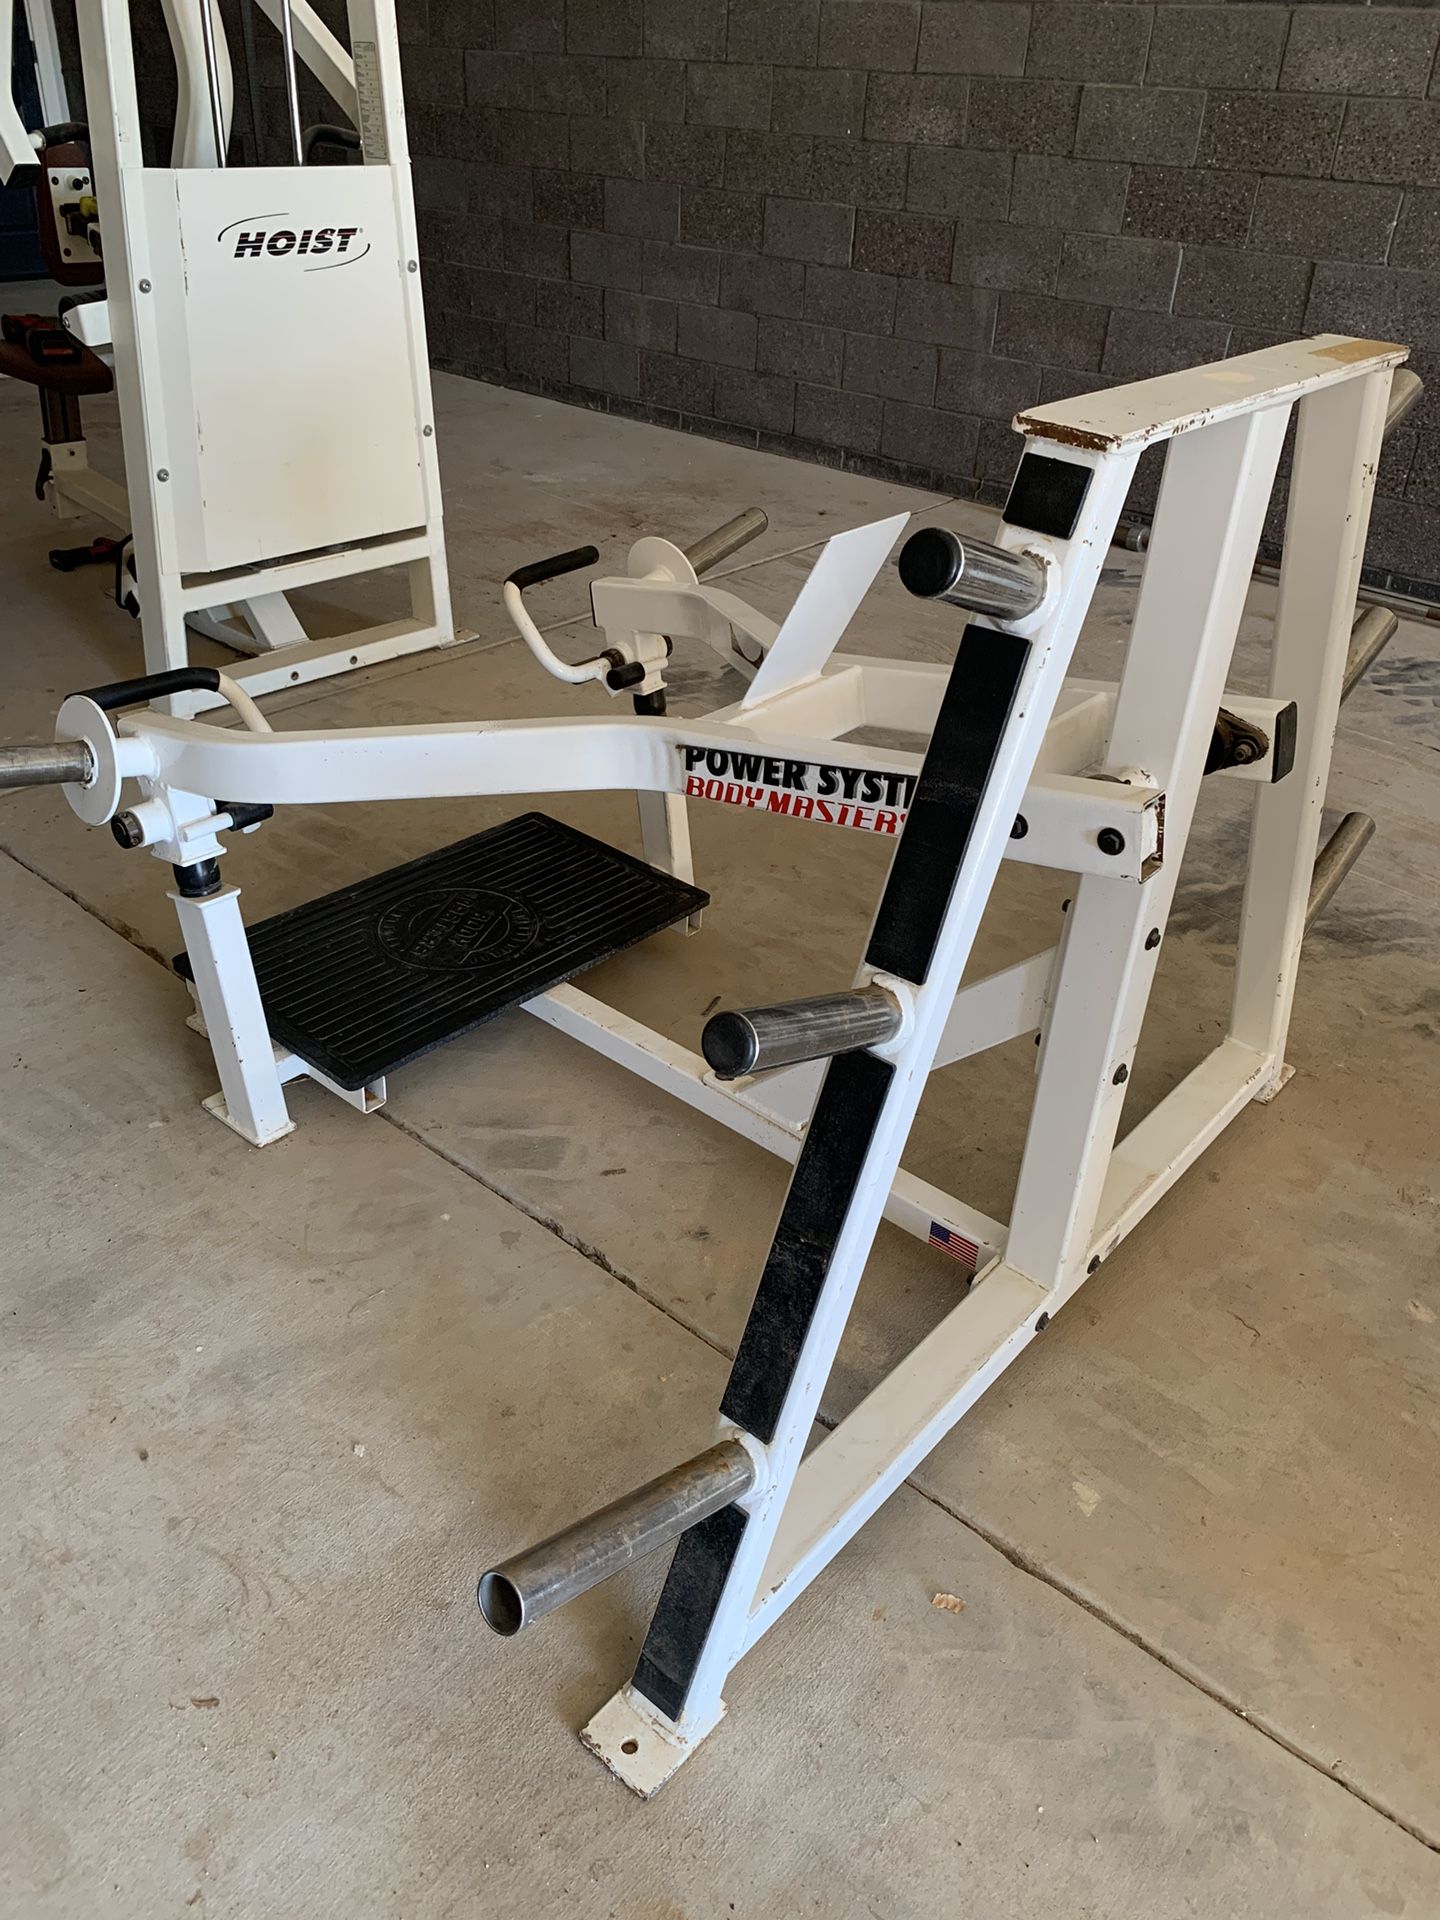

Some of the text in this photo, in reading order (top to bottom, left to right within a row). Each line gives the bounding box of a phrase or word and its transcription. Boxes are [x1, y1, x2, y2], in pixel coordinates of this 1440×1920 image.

[234, 227, 358, 259] HOIST
[684, 745, 808, 792] POWER
[765, 790, 907, 834] MASTER
